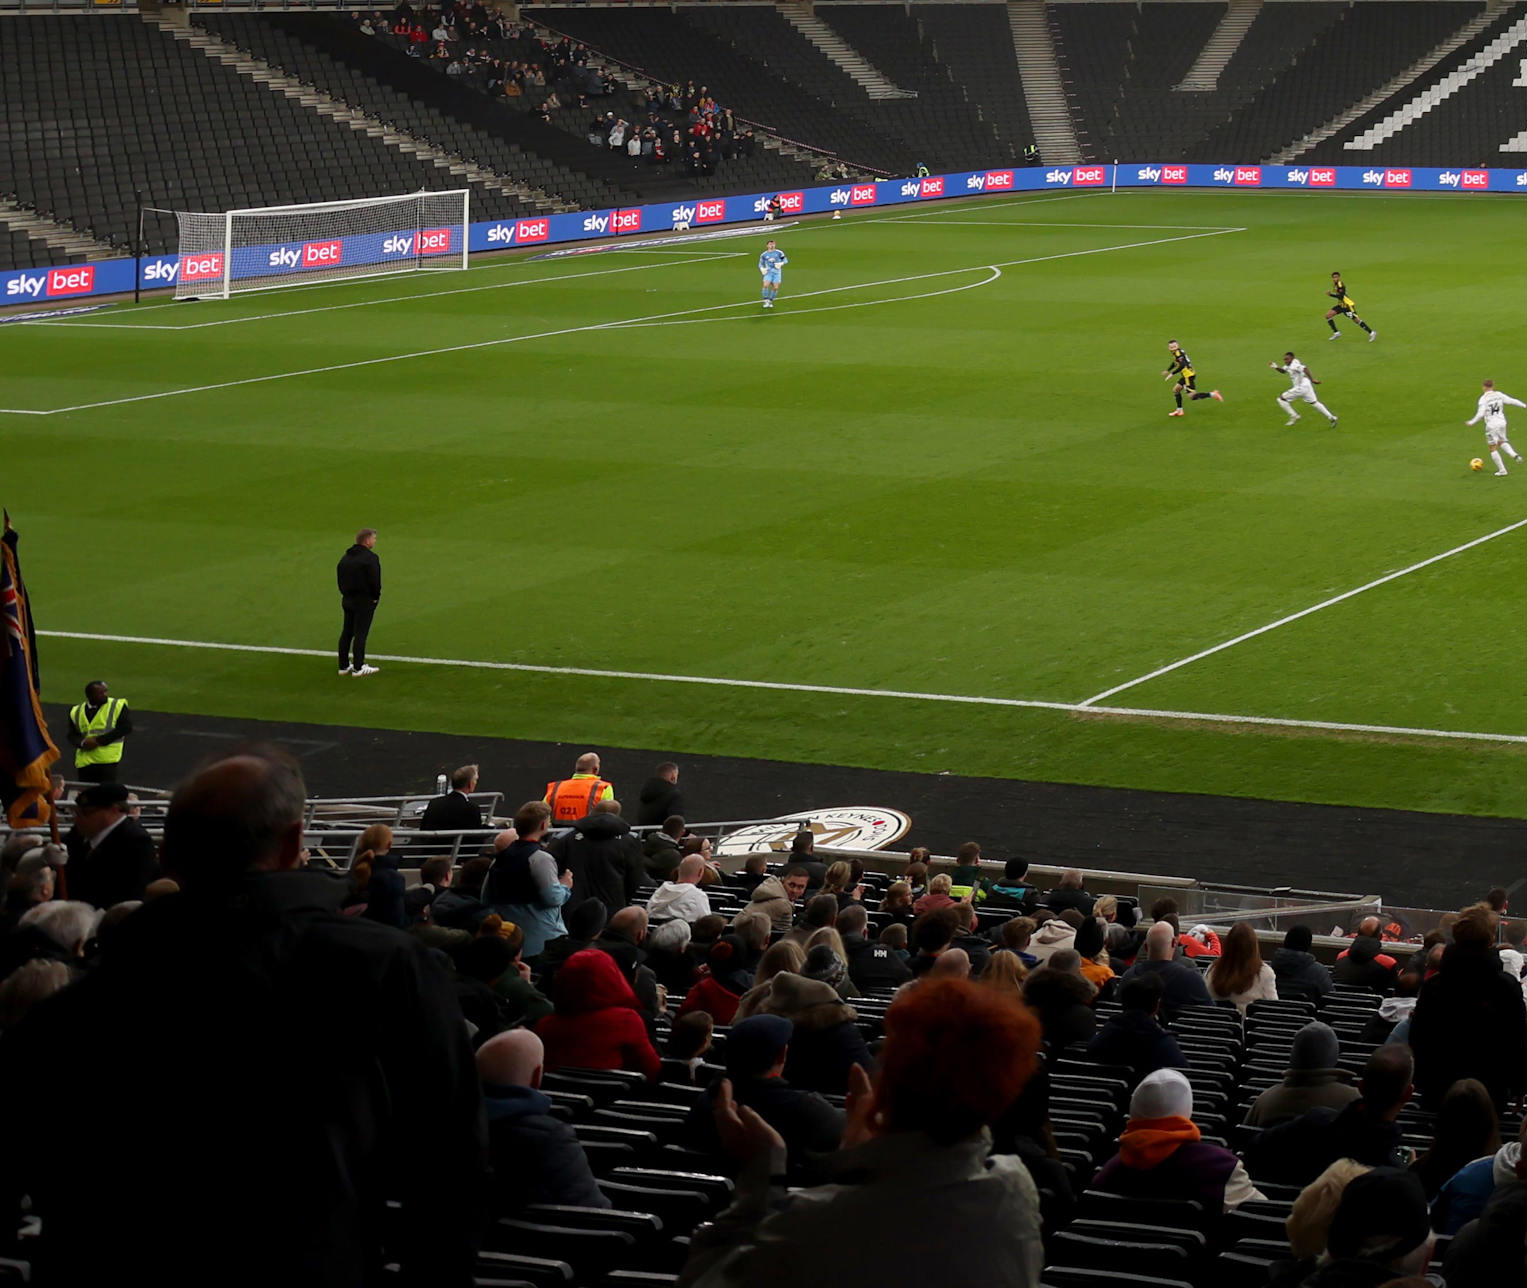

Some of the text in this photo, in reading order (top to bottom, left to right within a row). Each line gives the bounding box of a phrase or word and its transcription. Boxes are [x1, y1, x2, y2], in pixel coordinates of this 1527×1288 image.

[967, 174, 1010, 189] sky bet
[1046, 169, 1101, 184] sky bet
[1138, 167, 1184, 182] sky bet
[1214, 168, 1258, 183] sky bet
[1288, 169, 1333, 184] sky bet
[1363, 170, 1408, 185] sky bet
[1439, 171, 1486, 187] sky bet
[831, 188, 873, 205] sky bet
[902, 181, 941, 197] sky bet
[673, 204, 722, 222] sky bet
[584, 213, 637, 232] sky bet
[488, 222, 545, 243] sky bet
[270, 244, 338, 267] sky bet
[144, 256, 219, 281] sky bet
[7, 271, 89, 296] sky bet
[1489, 402, 1500, 416] 14
[873, 949, 888, 958] HH
